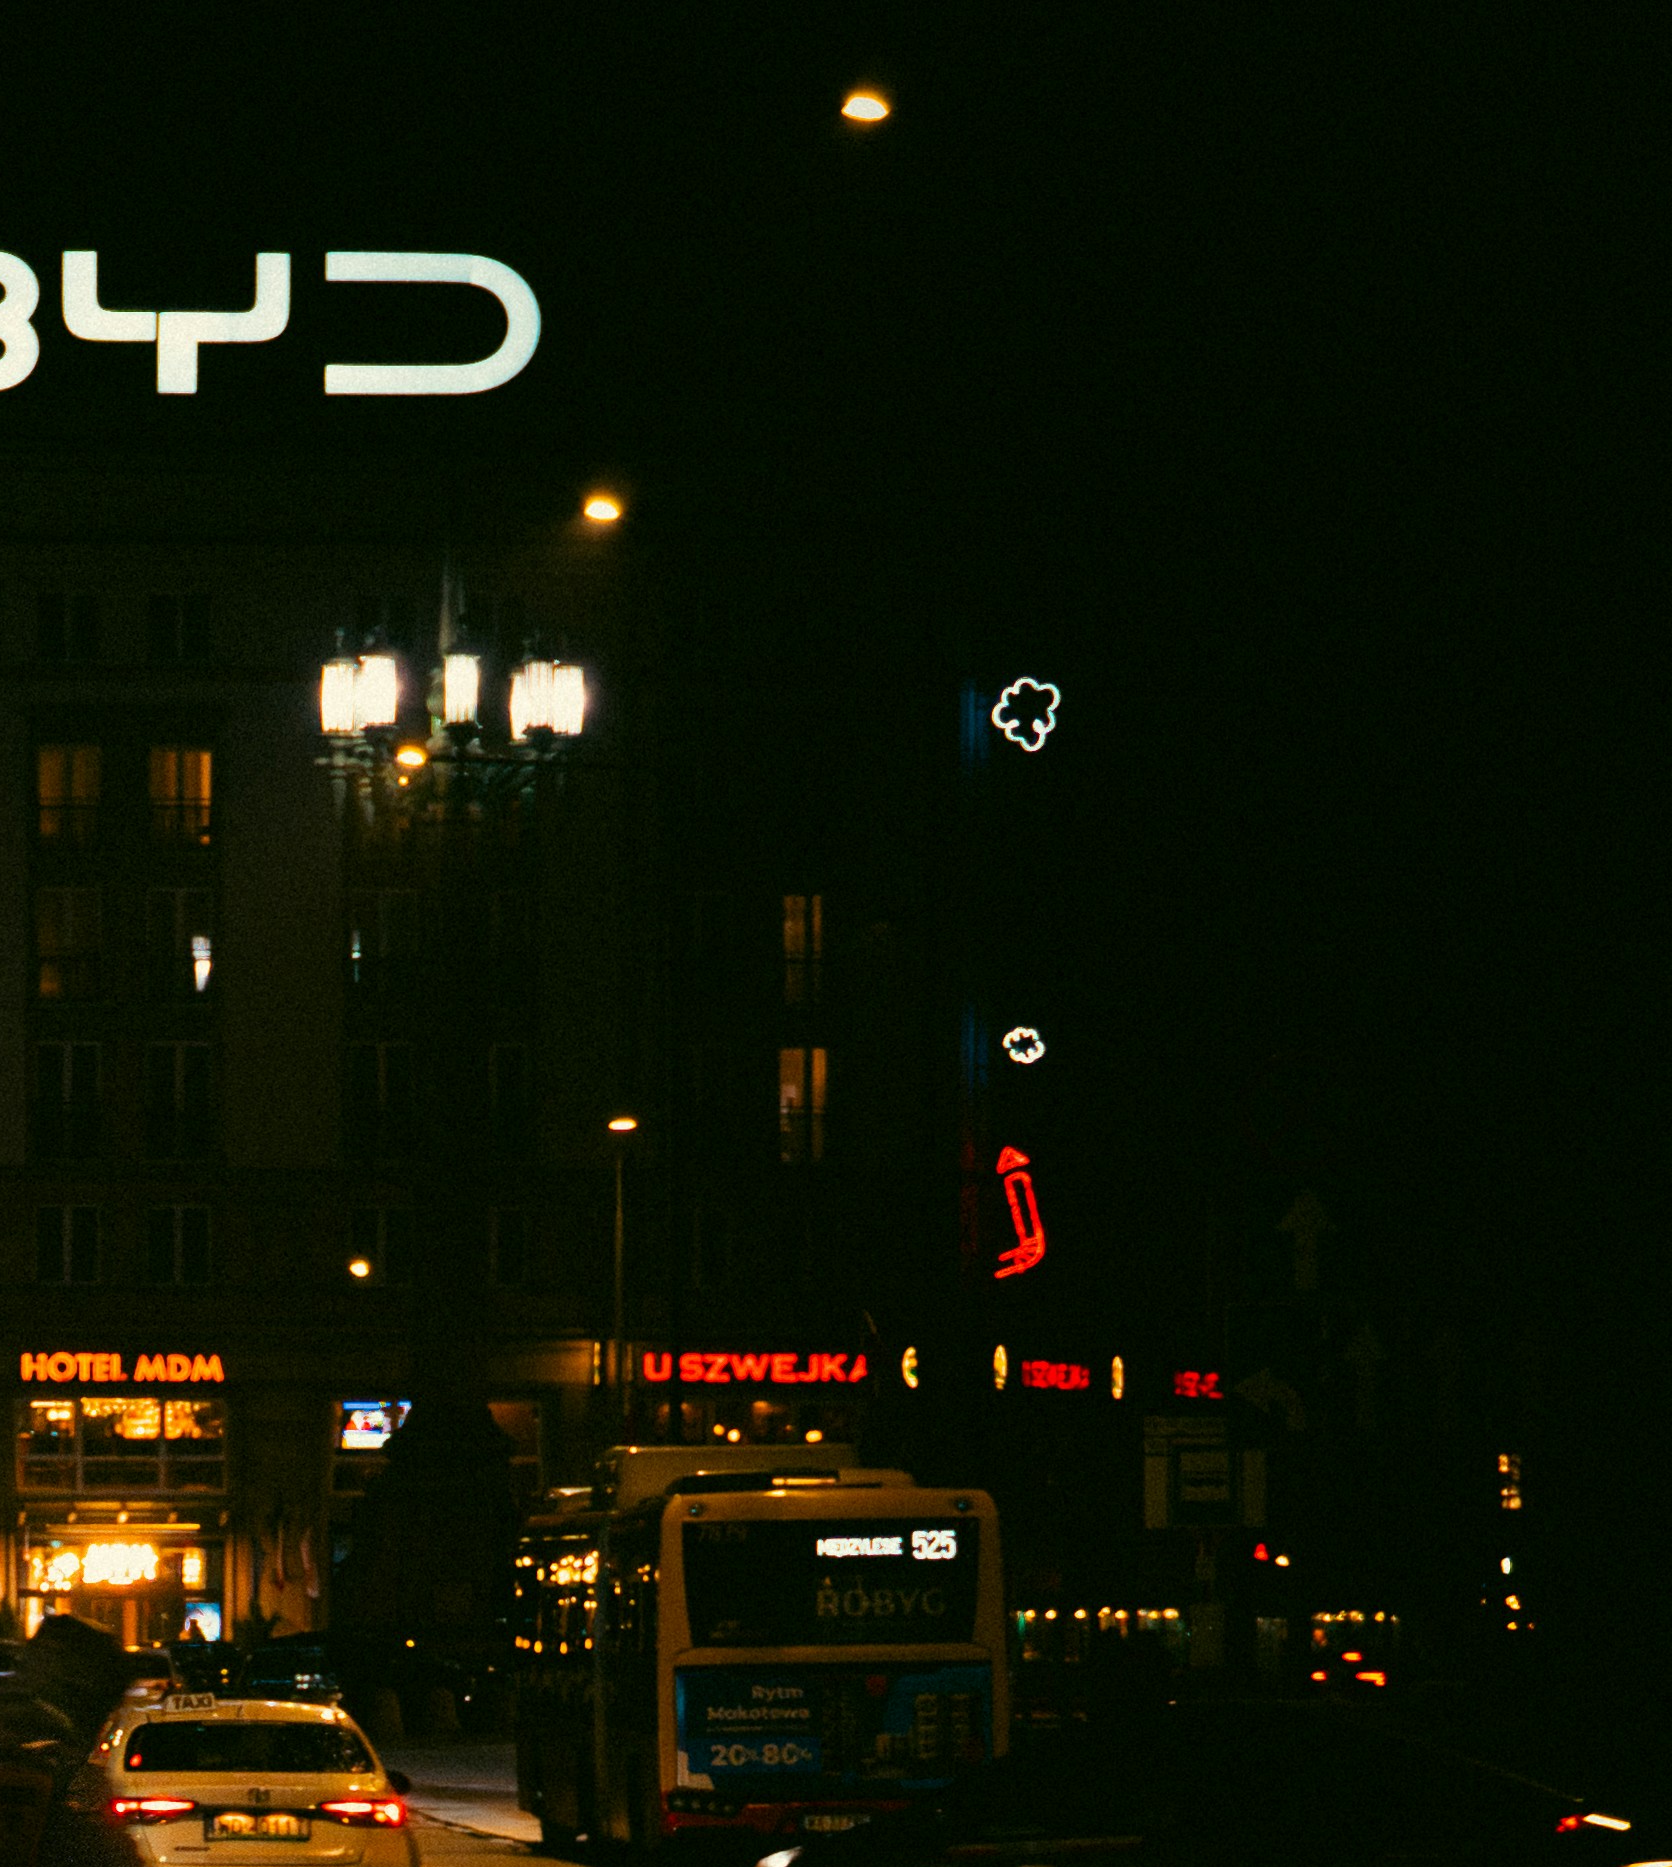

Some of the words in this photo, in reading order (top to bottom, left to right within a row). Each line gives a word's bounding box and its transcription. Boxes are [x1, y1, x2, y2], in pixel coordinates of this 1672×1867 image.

[20, 1352, 128, 1383] HOTEL
[133, 1353, 225, 1383] MDM
[642, 1351, 673, 1382] U
[912, 1530, 957, 1560] 525
[172, 1694, 212, 1710] TAXI
[751, 1685, 804, 1702] Rytm
